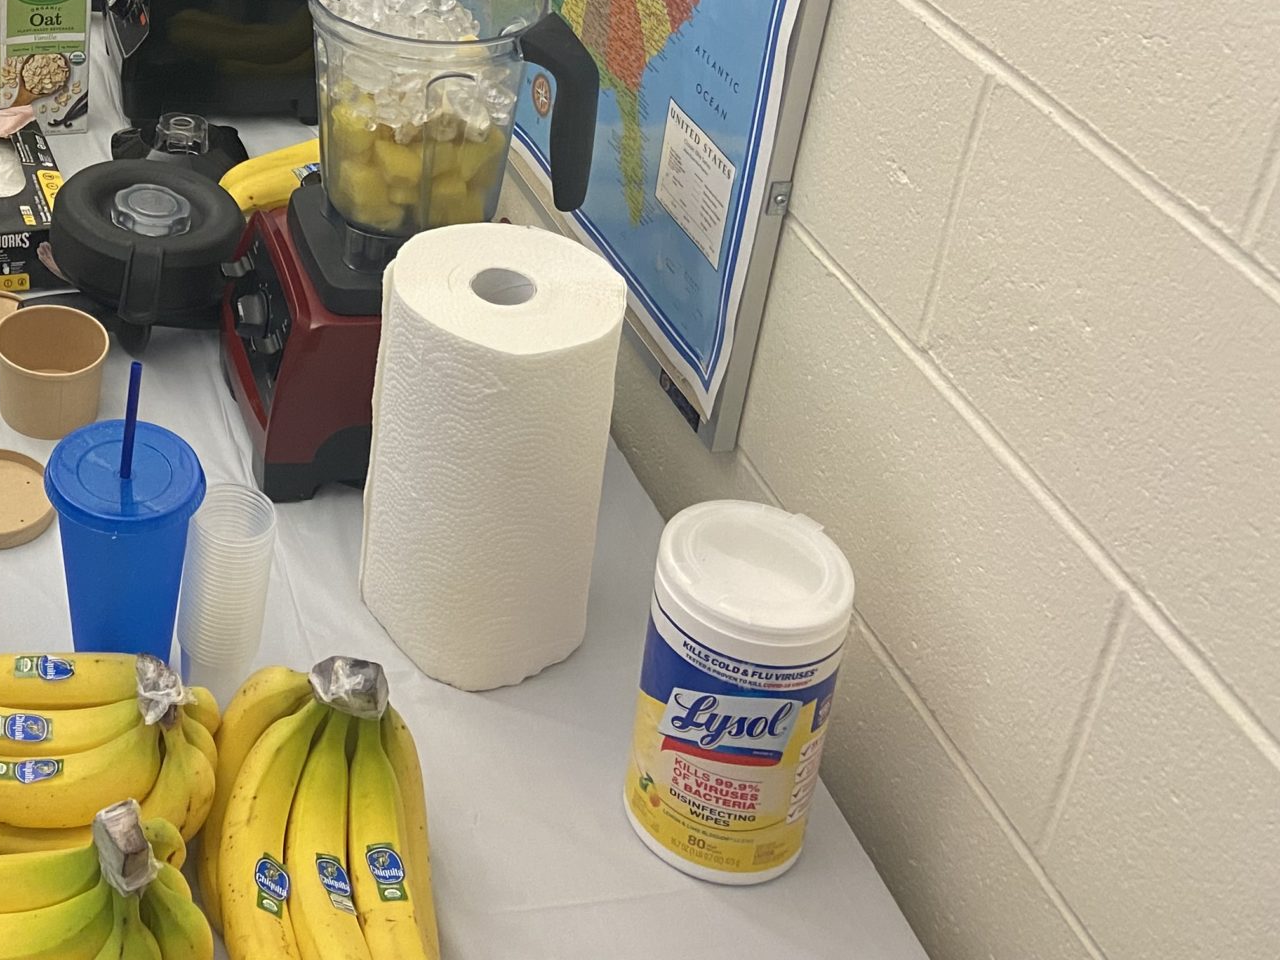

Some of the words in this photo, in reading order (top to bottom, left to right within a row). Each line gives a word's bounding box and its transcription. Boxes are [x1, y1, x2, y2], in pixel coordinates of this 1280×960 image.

[30, 12, 62, 27] Oat
[695, 44, 740, 94] ATLANTIC
[696, 83, 728, 121] OCEAN
[670, 108, 701, 145] UNITED
[704, 142, 732, 180] STATES
[682, 640, 710, 662] KILLS
[711, 658, 740, 674] COLD
[741, 668, 750, 678] &
[750, 670, 774, 680] FLU
[774, 668, 816, 681] VIRUSES
[685, 653, 706, 670] TESTED
[712, 668, 738, 682] PROVEN
[13, 714, 26, 740] Chiquita
[671, 692, 792, 746] Lysol
[673, 766, 690, 784] OF
[694, 778, 758, 801] VIRUSES
[674, 757, 710, 782] KILLS
[715, 778, 760, 792] 99.9%
[670, 788, 756, 822] DISINFECTING
[672, 778, 680, 786] &
[684, 784, 757, 810] BACTERIA
[686, 824, 700, 834] LIME
[690, 808, 730, 828] WIPES
[688, 834, 706, 850] 80
[256, 872, 288, 898] Chiquita
[320, 874, 350, 891] Chiquita
[370, 864, 404, 878] Chiquita
